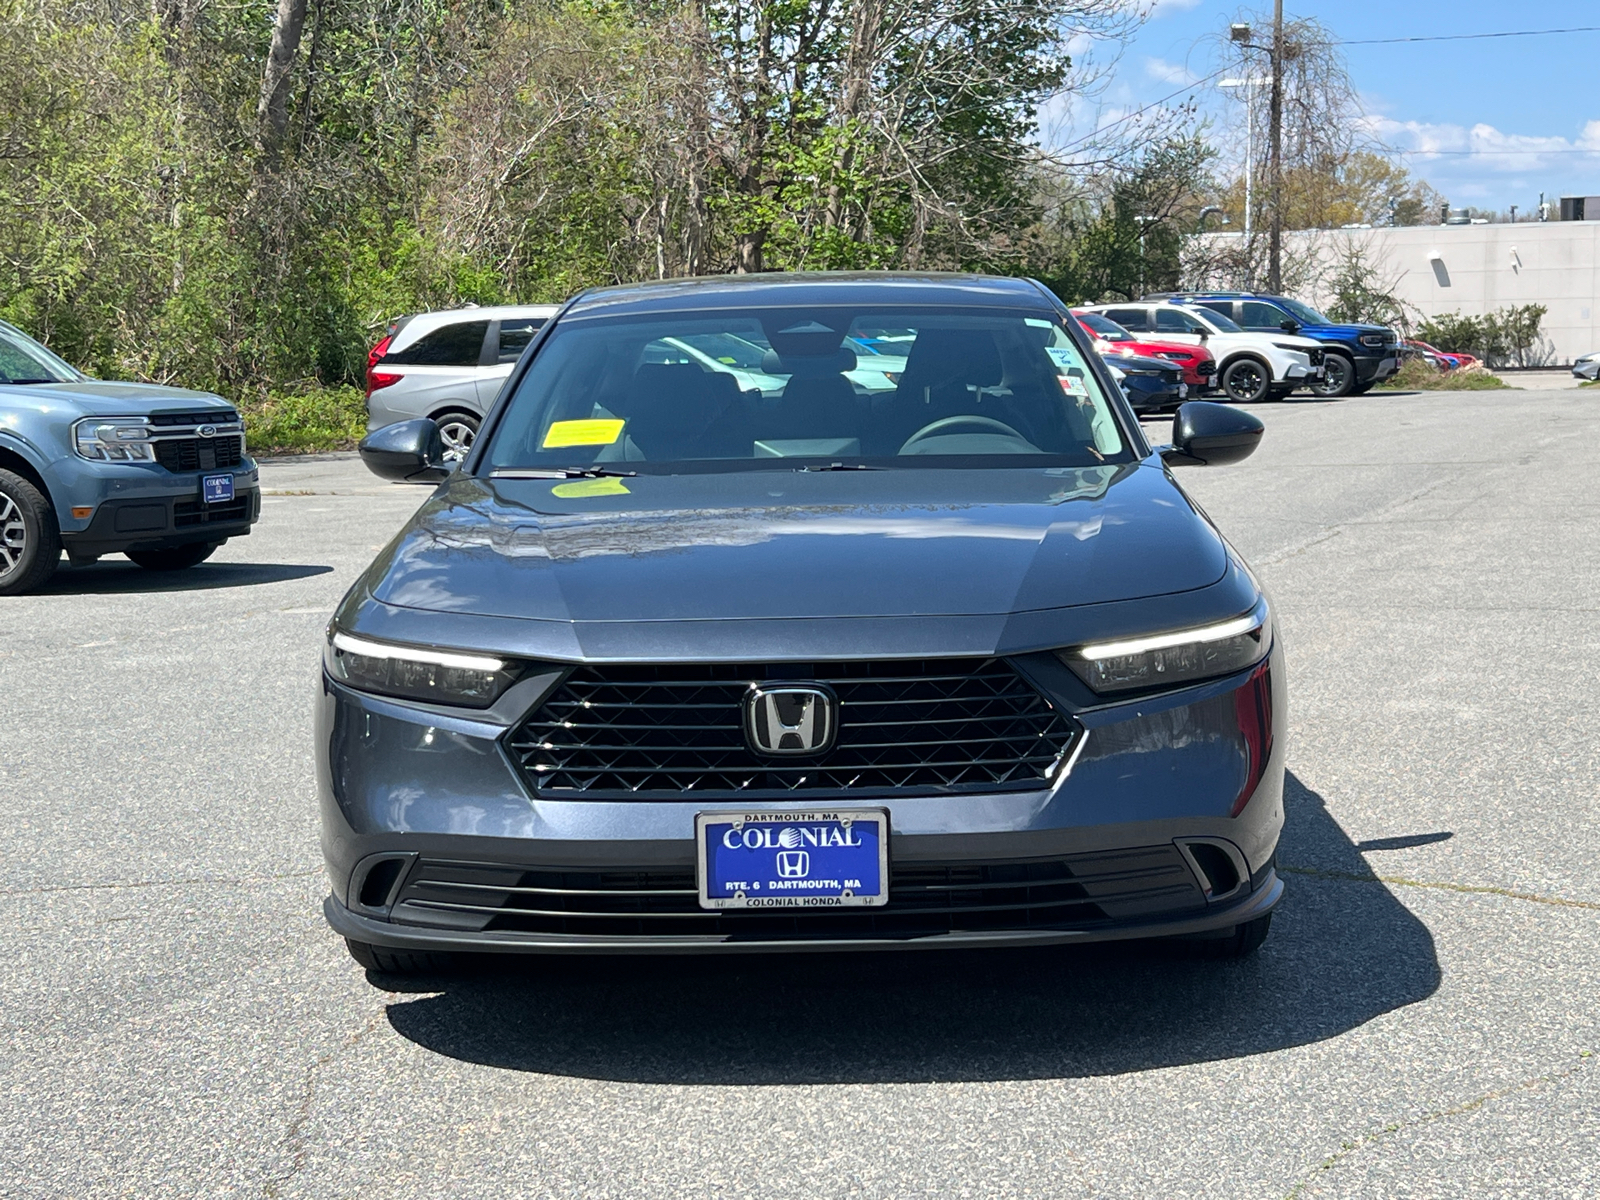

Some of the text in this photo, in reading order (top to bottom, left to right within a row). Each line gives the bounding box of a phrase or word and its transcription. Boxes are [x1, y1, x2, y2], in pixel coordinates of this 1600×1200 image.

[822, 812, 839, 821] MA
[722, 826, 862, 849] COLONIAL
[725, 879, 862, 890] RTE. 6 DARTMOUTH, MA
[746, 896, 842, 907] COLONIAL HONDA
